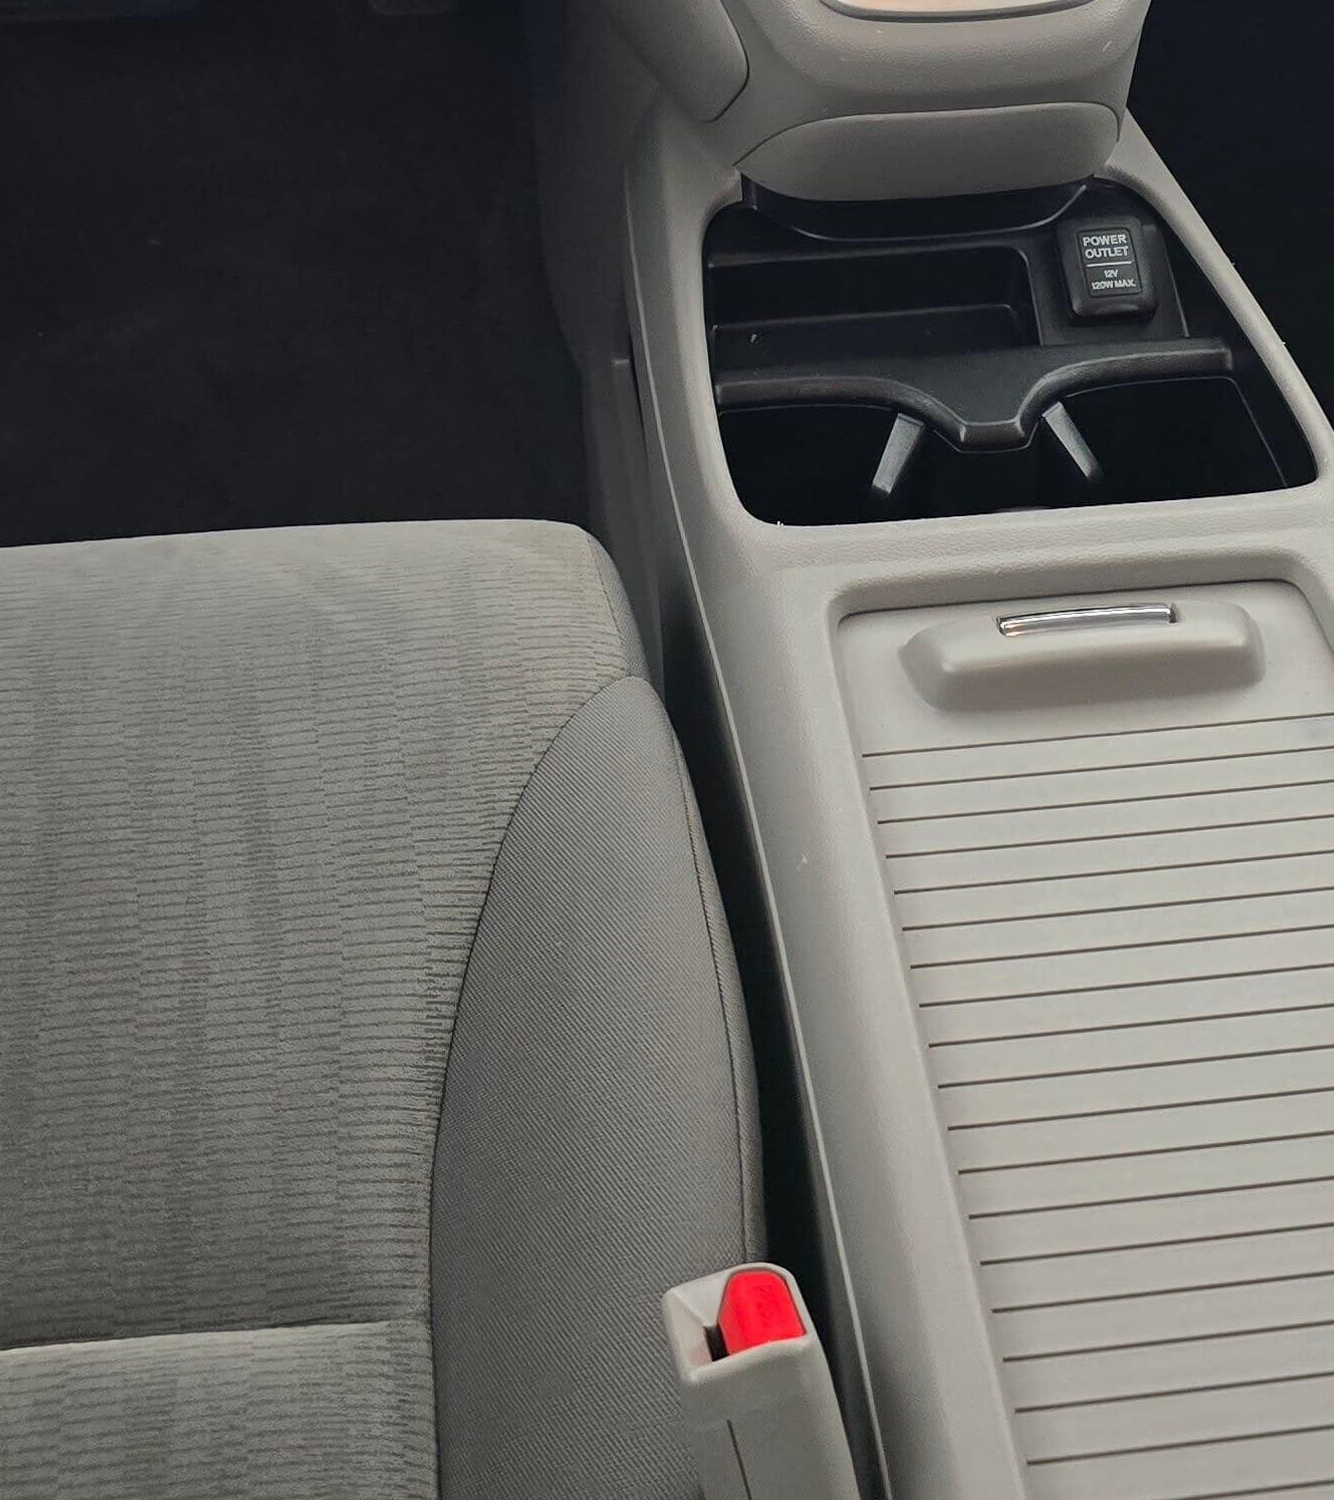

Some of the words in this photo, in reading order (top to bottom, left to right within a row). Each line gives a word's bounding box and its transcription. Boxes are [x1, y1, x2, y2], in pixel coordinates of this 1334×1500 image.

[1082, 234, 1127, 247] POWER
[1085, 246, 1129, 259] OUTLET
[1103, 269, 1119, 278] 12V
[1091, 280, 1113, 290] 120W
